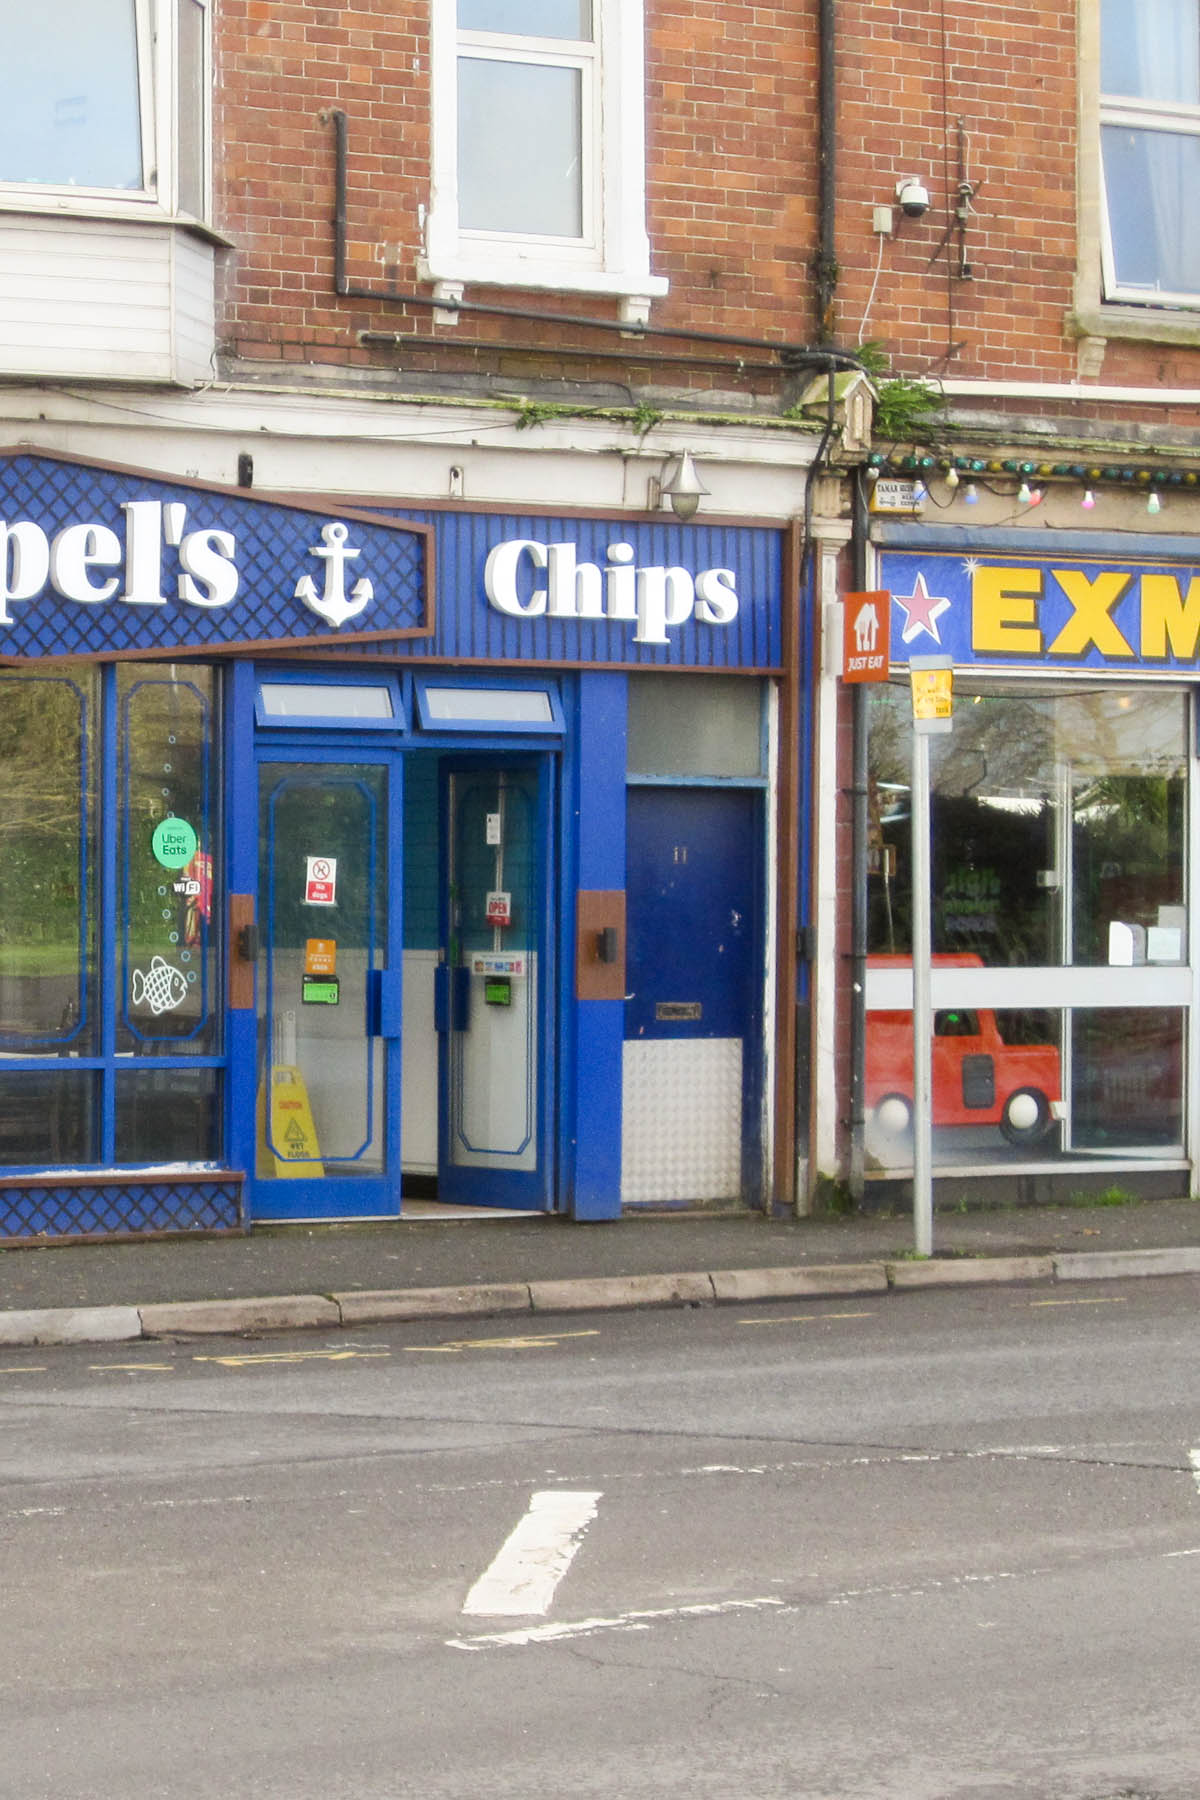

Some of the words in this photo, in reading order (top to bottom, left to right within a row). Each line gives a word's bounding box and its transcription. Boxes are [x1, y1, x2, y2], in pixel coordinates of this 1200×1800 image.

[484, 539, 739, 644] Chips
[972, 566, 1200, 662] EXM
[847, 657, 868, 672] JUST
[868, 655, 884, 669] EAT
[162, 833, 187, 844] Uber
[162, 845, 187, 856] Eats
[488, 902, 508, 914] OPEN
